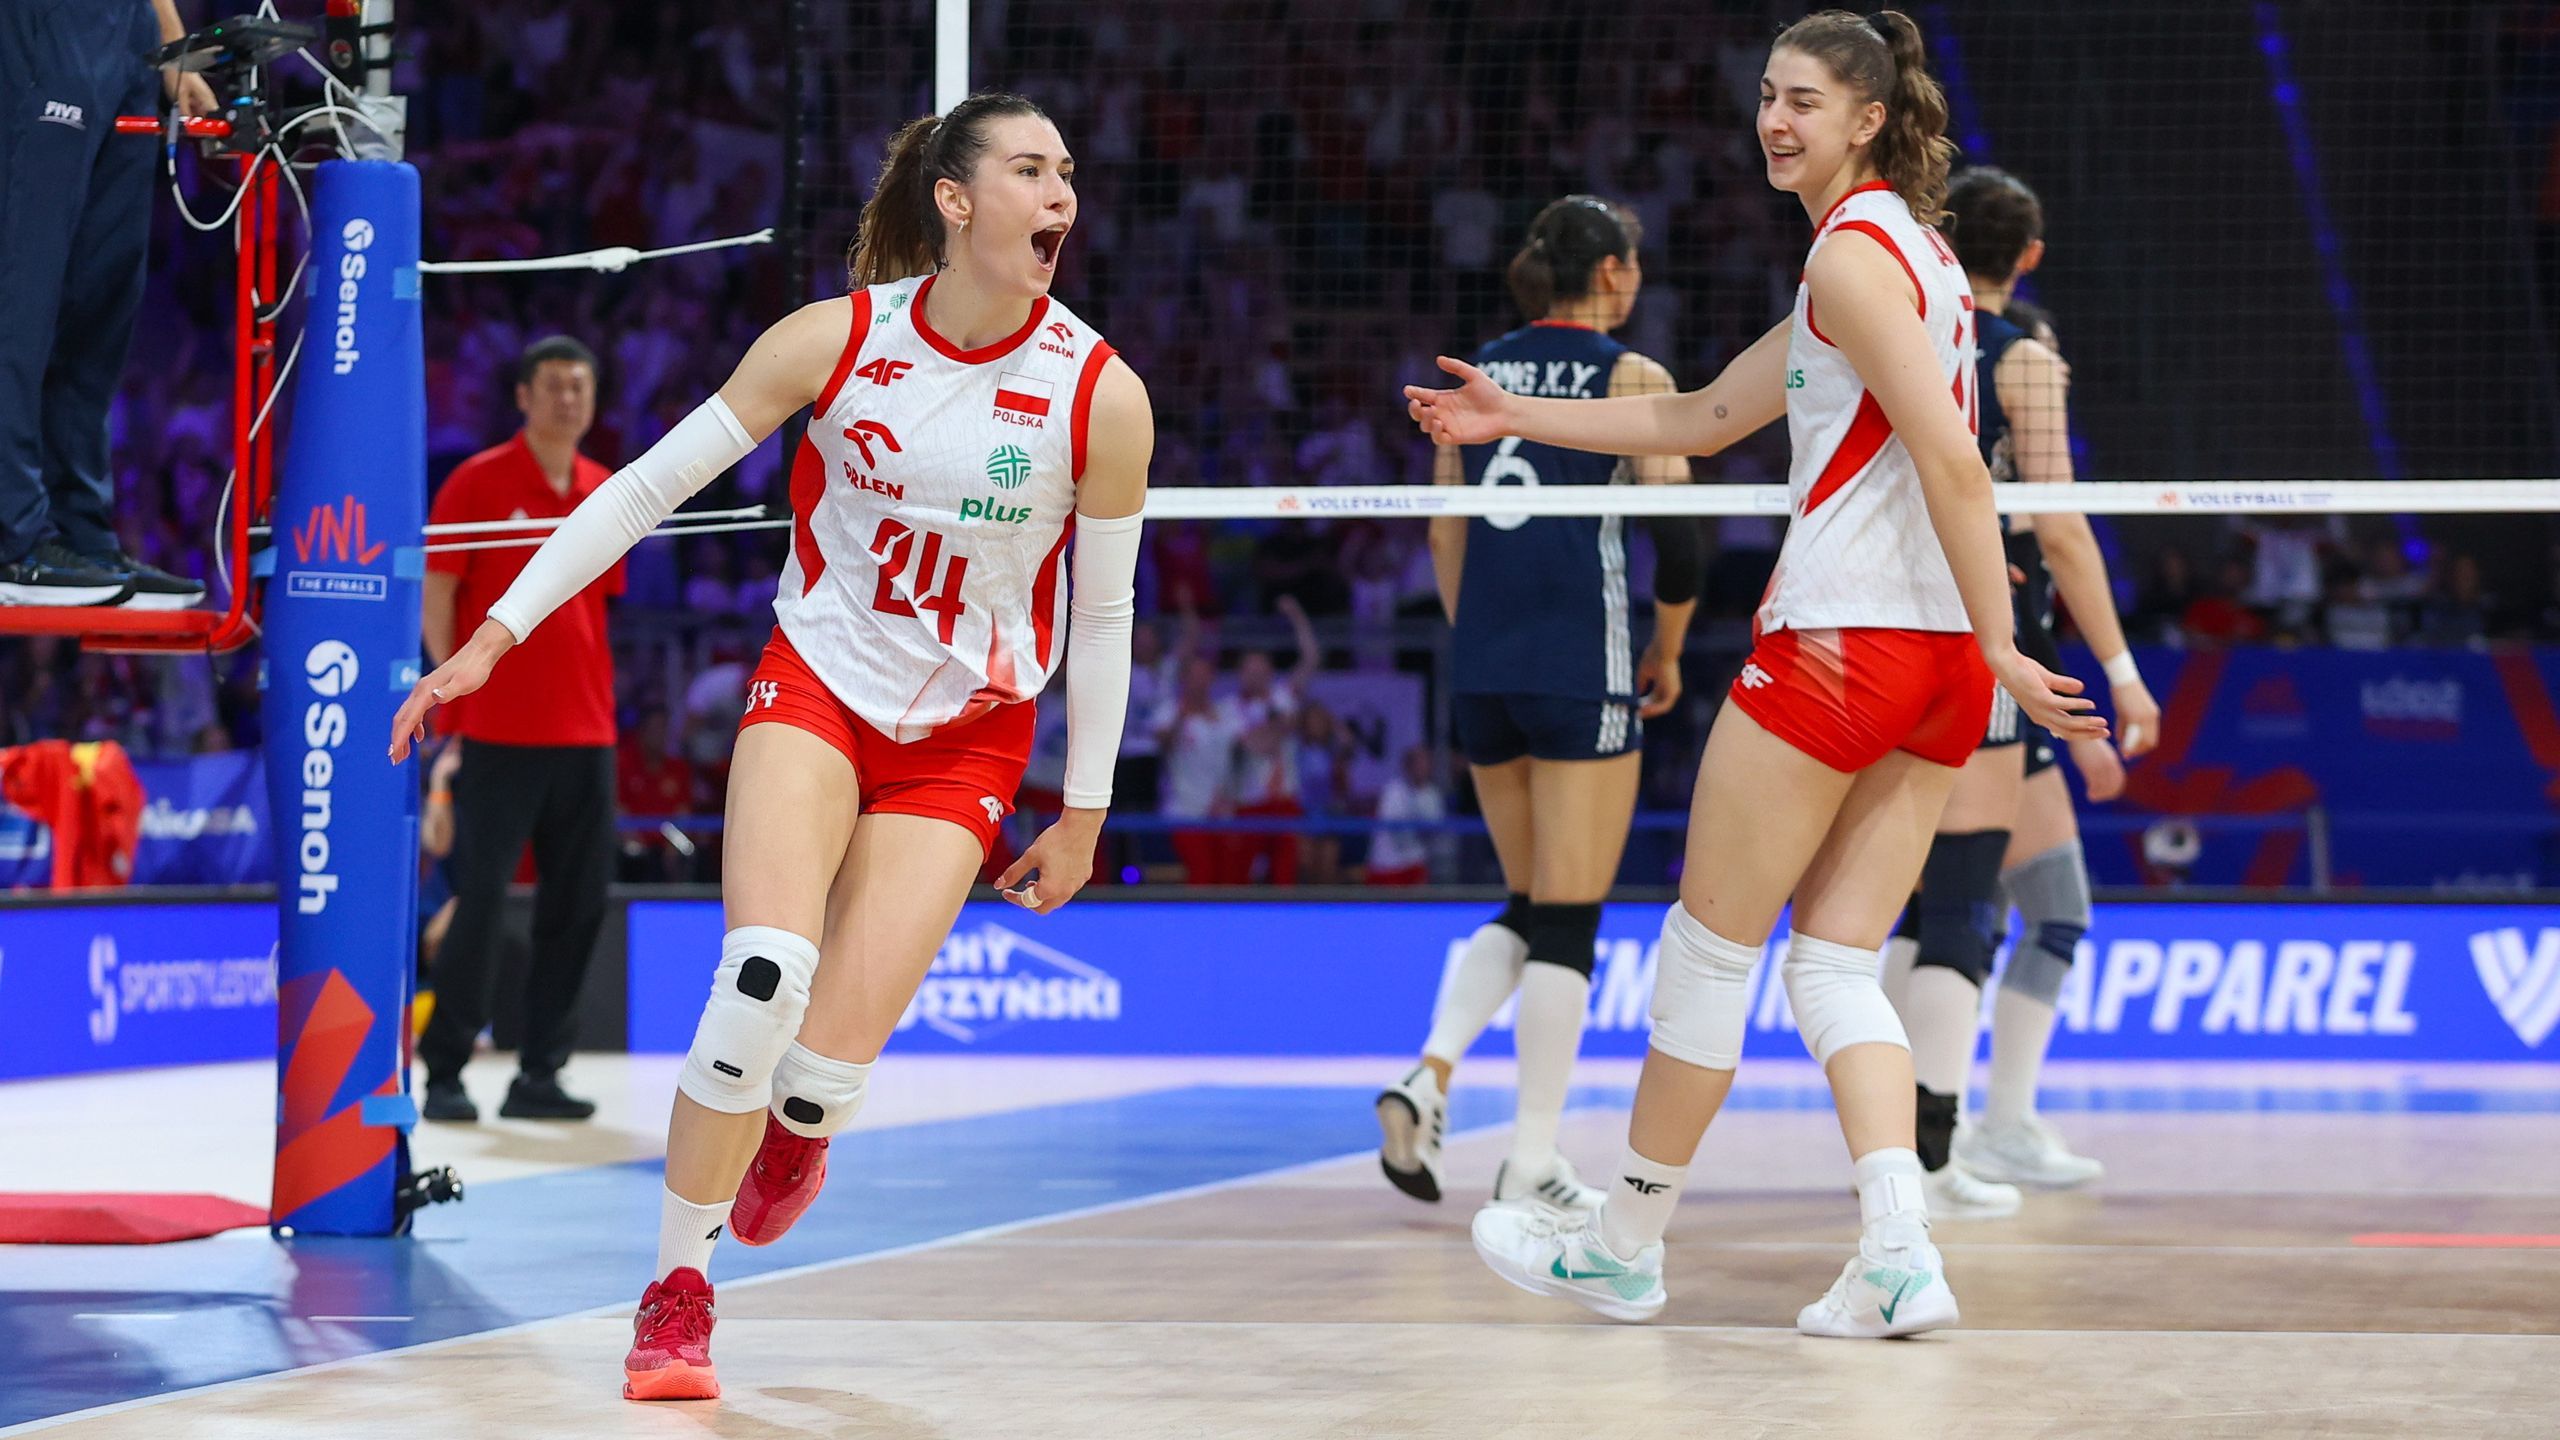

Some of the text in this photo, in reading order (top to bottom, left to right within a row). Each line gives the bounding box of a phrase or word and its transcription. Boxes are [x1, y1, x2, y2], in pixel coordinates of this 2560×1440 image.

[334, 252, 367, 374] Senoh
[855, 358, 914, 387] 4F
[1477, 361, 1538, 395] ONG
[992, 409, 1043, 429] POLSKA
[843, 460, 904, 500] ORLEN
[1480, 436, 1541, 531] 6
[958, 497, 1033, 524] plus
[1307, 496, 1412, 510] VOLLEYBALL
[2187, 492, 2296, 506] VOLLEYBALL
[292, 495, 387, 565] VNL
[298, 577, 376, 594] THE FINALS
[868, 518, 969, 646] 24
[299, 701, 348, 915] Senoh
[2058, 939, 2418, 1035] APPAREL
